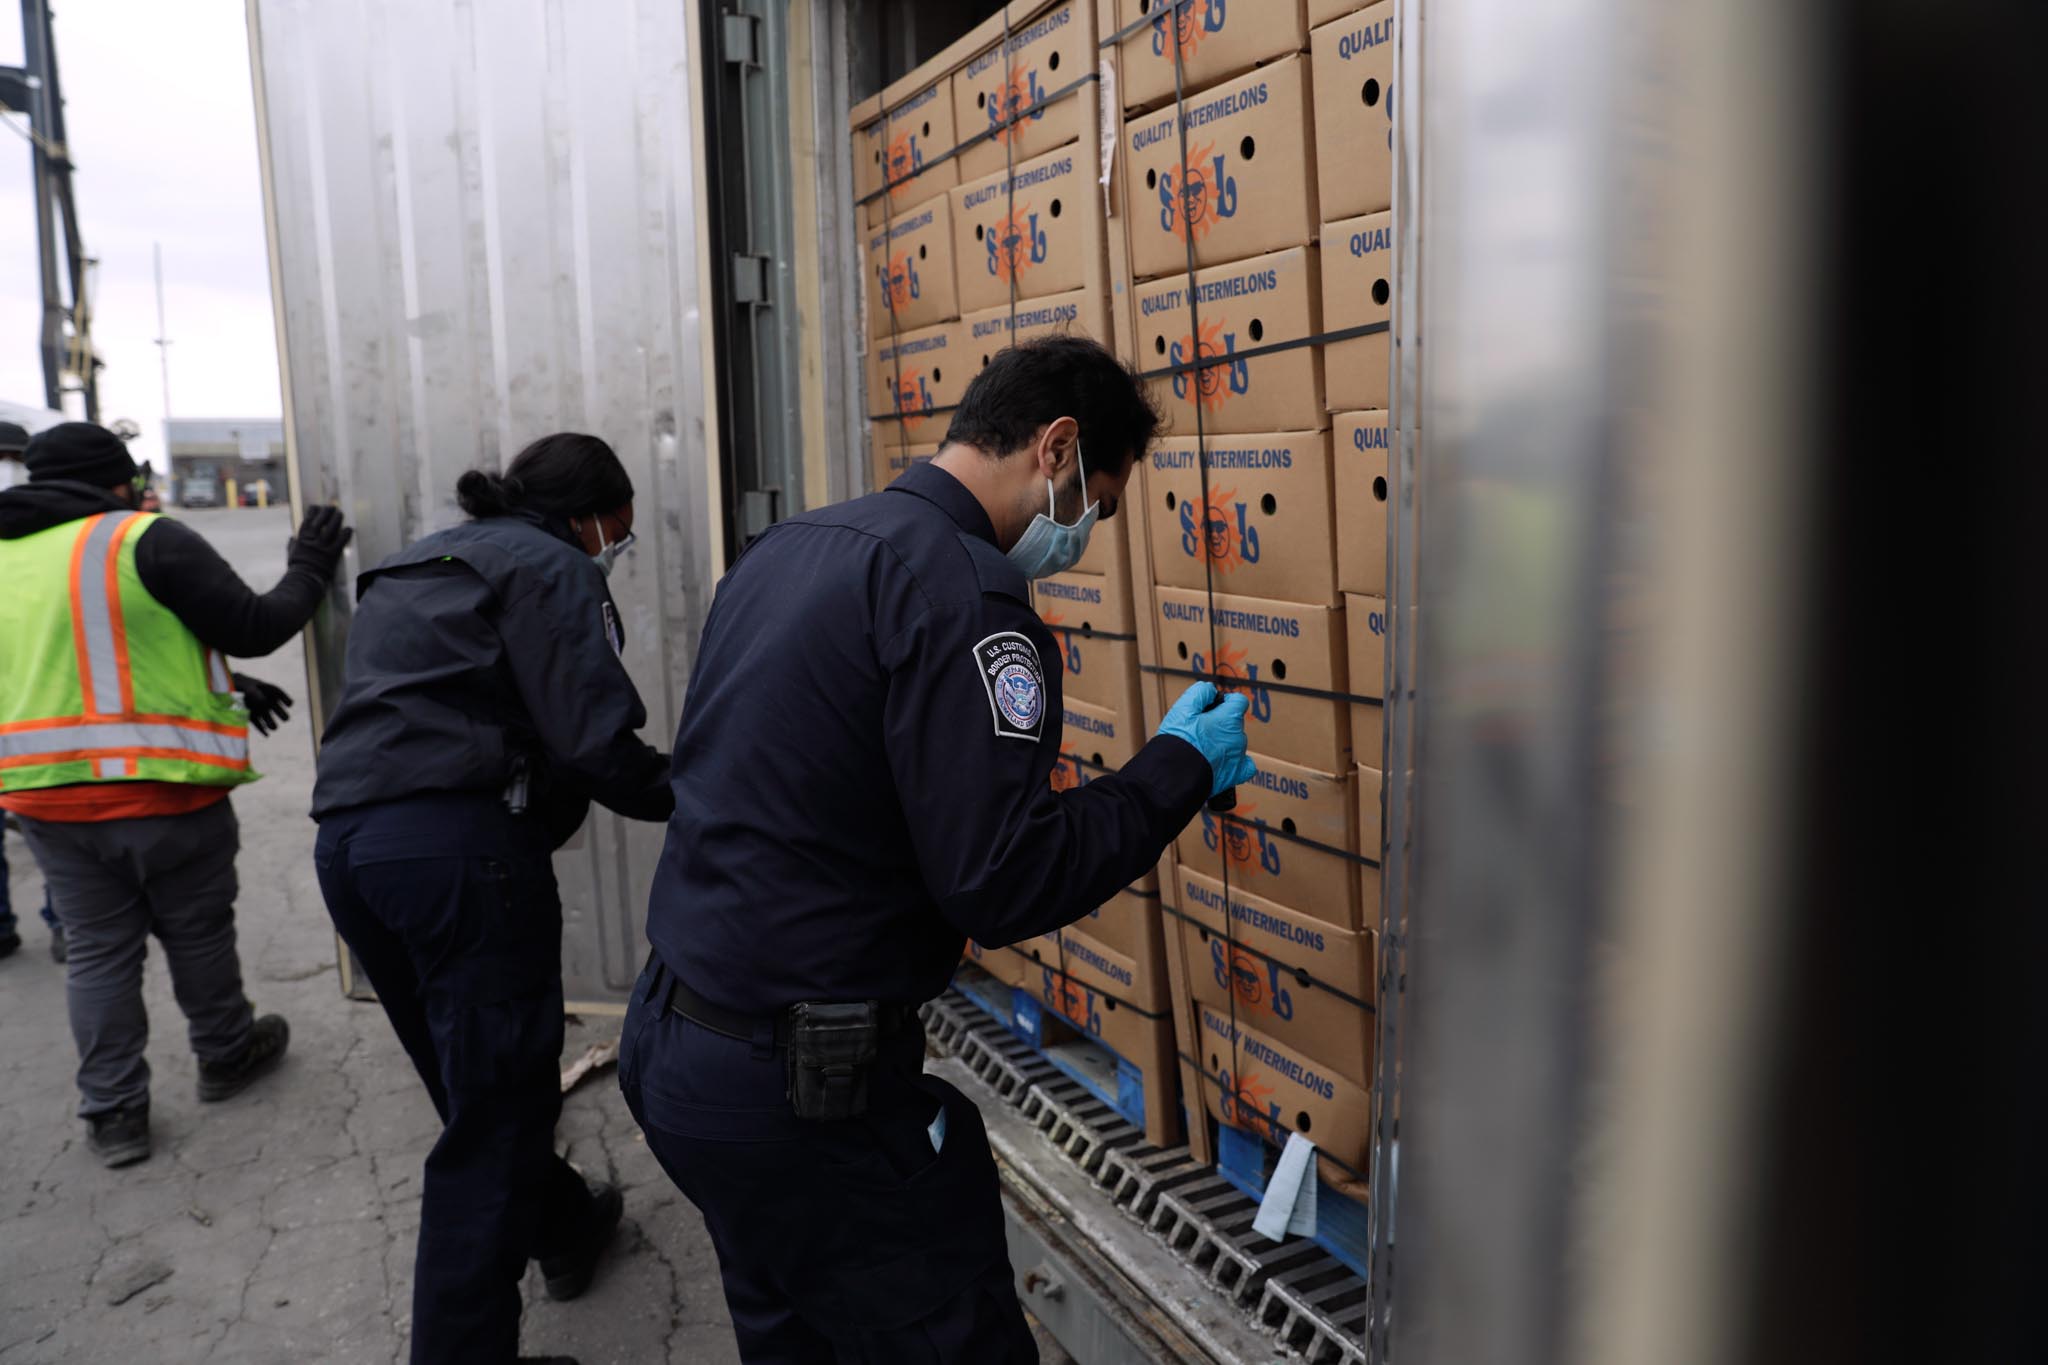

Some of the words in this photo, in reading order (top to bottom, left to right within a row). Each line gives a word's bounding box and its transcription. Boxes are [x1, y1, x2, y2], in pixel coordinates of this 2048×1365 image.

[1338, 16, 1394, 60] QUALI
[1132, 119, 1174, 151] QUALITY
[1178, 82, 1268, 132] ATERMELONS
[1141, 289, 1182, 316] QUALITY
[1153, 450, 1195, 471] QUALITY
[1163, 601, 1205, 624] QUALITY
[988, 654, 1012, 676] BORDER
[1229, 901, 1325, 951] WATERMELONS
[1243, 1034, 1335, 1100] WATERMELONS
